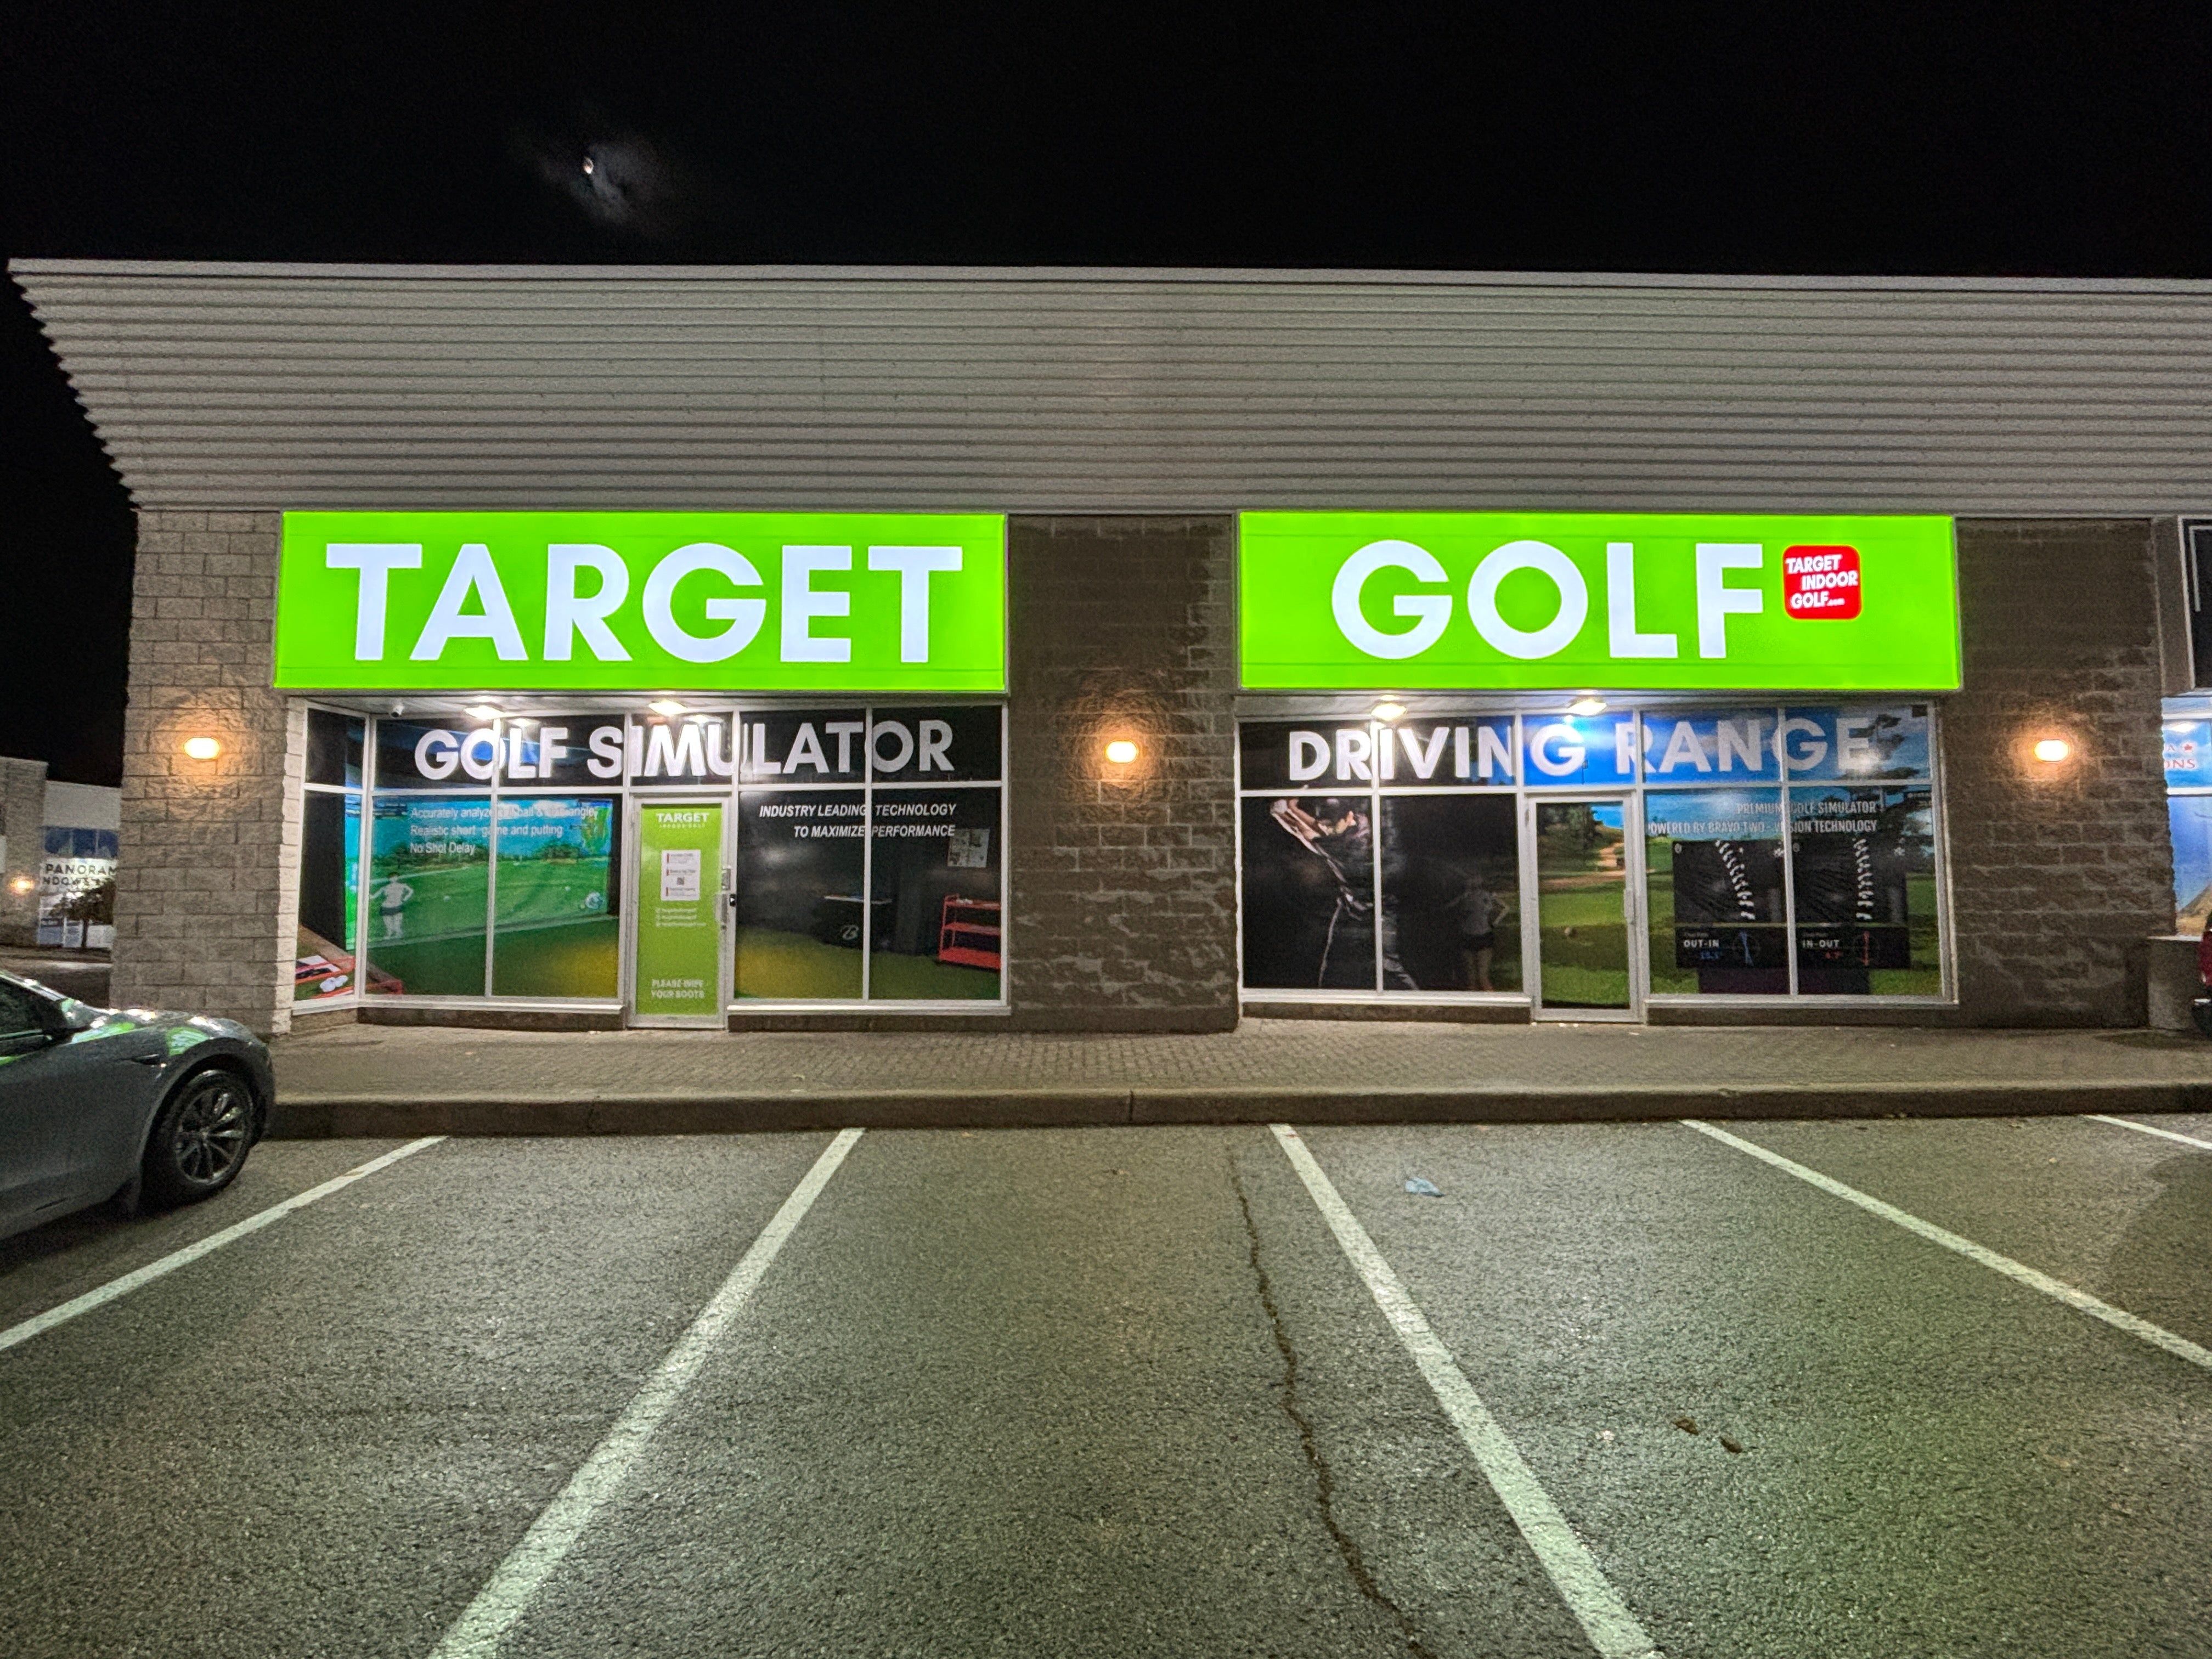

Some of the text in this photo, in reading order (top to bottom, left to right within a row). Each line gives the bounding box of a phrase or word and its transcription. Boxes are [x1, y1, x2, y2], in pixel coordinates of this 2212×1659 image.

[1785, 554, 1843, 574] TARGET
[1802, 570, 1858, 591] INDOOR
[326, 542, 962, 662] TARGET
[1331, 540, 1763, 659] GOLF
[415, 719, 955, 780] GOLF SIMULATOR
[1289, 718, 1872, 780] DRIVING RANGE
[759, 803, 957, 817] INDUSTRY LEADING TECHNOLOGY
[1818, 800, 1876, 814] SIMULATOR
[411, 808, 458, 821] Accurately
[656, 812, 710, 823] TARGET
[410, 825, 449, 836] Realistic
[452, 825, 476, 836] short
[510, 825, 529, 836] and
[531, 825, 563, 839] putting
[794, 825, 956, 838] TO MAXIMIZE PERFORMANCE
[1815, 820, 1877, 832] TECHNOLOGY
[410, 842, 475, 856] No Shot Delay
[1683, 939, 1719, 949] OUT-IN
